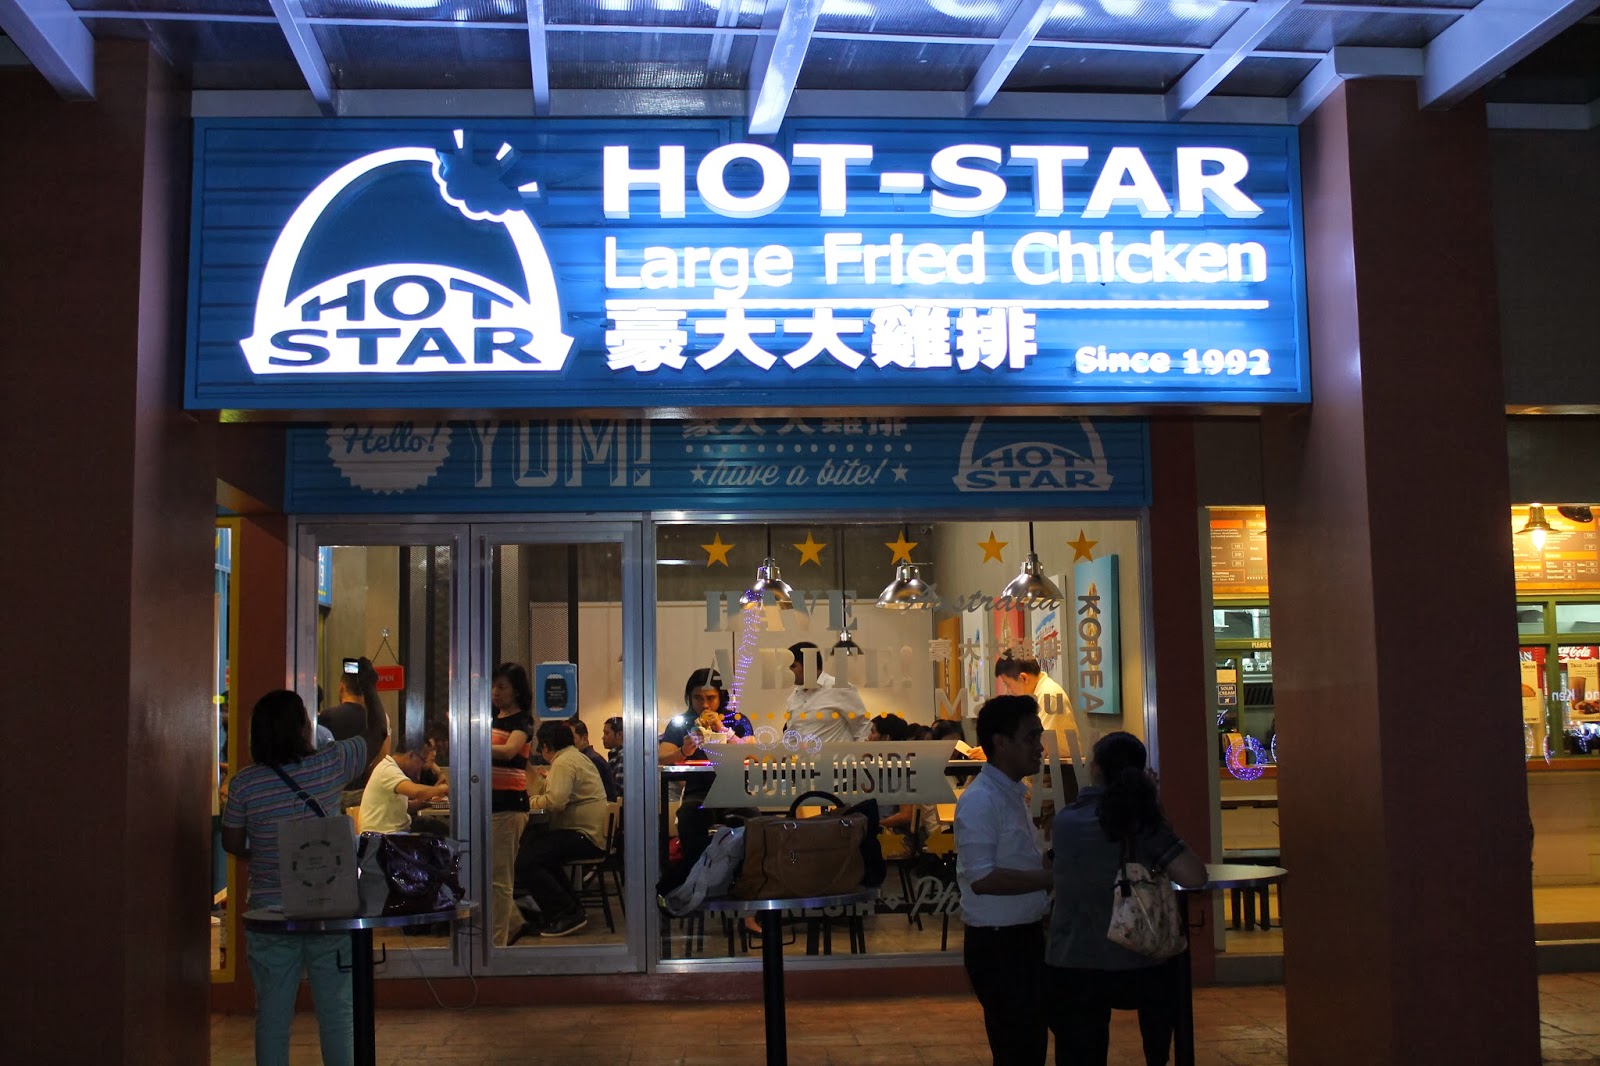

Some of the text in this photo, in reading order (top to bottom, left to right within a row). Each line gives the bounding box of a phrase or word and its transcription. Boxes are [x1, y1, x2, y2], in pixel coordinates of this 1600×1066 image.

[602, 143, 1264, 218] HOT-STAR
[605, 229, 1268, 299] Large Fried Chicken
[301, 275, 514, 321] HOT
[269, 327, 542, 365] STAR
[605, 306, 1037, 371] 豪大大雞排
[1075, 345, 1271, 376] Since 1992
[343, 421, 442, 454] Hello!
[470, 418, 651, 488] YUM!
[982, 446, 1088, 468] HOT
[707, 457, 888, 486] have a bite!
[966, 470, 1099, 489] STAR
[704, 590, 857, 632] HAVE
[901, 583, 1061, 615] Australia
[702, 649, 736, 690] A
[928, 638, 1062, 662] 豪大大雞排
[1078, 595, 1104, 713] KOREA
[743, 752, 917, 796] COME INSIDE
